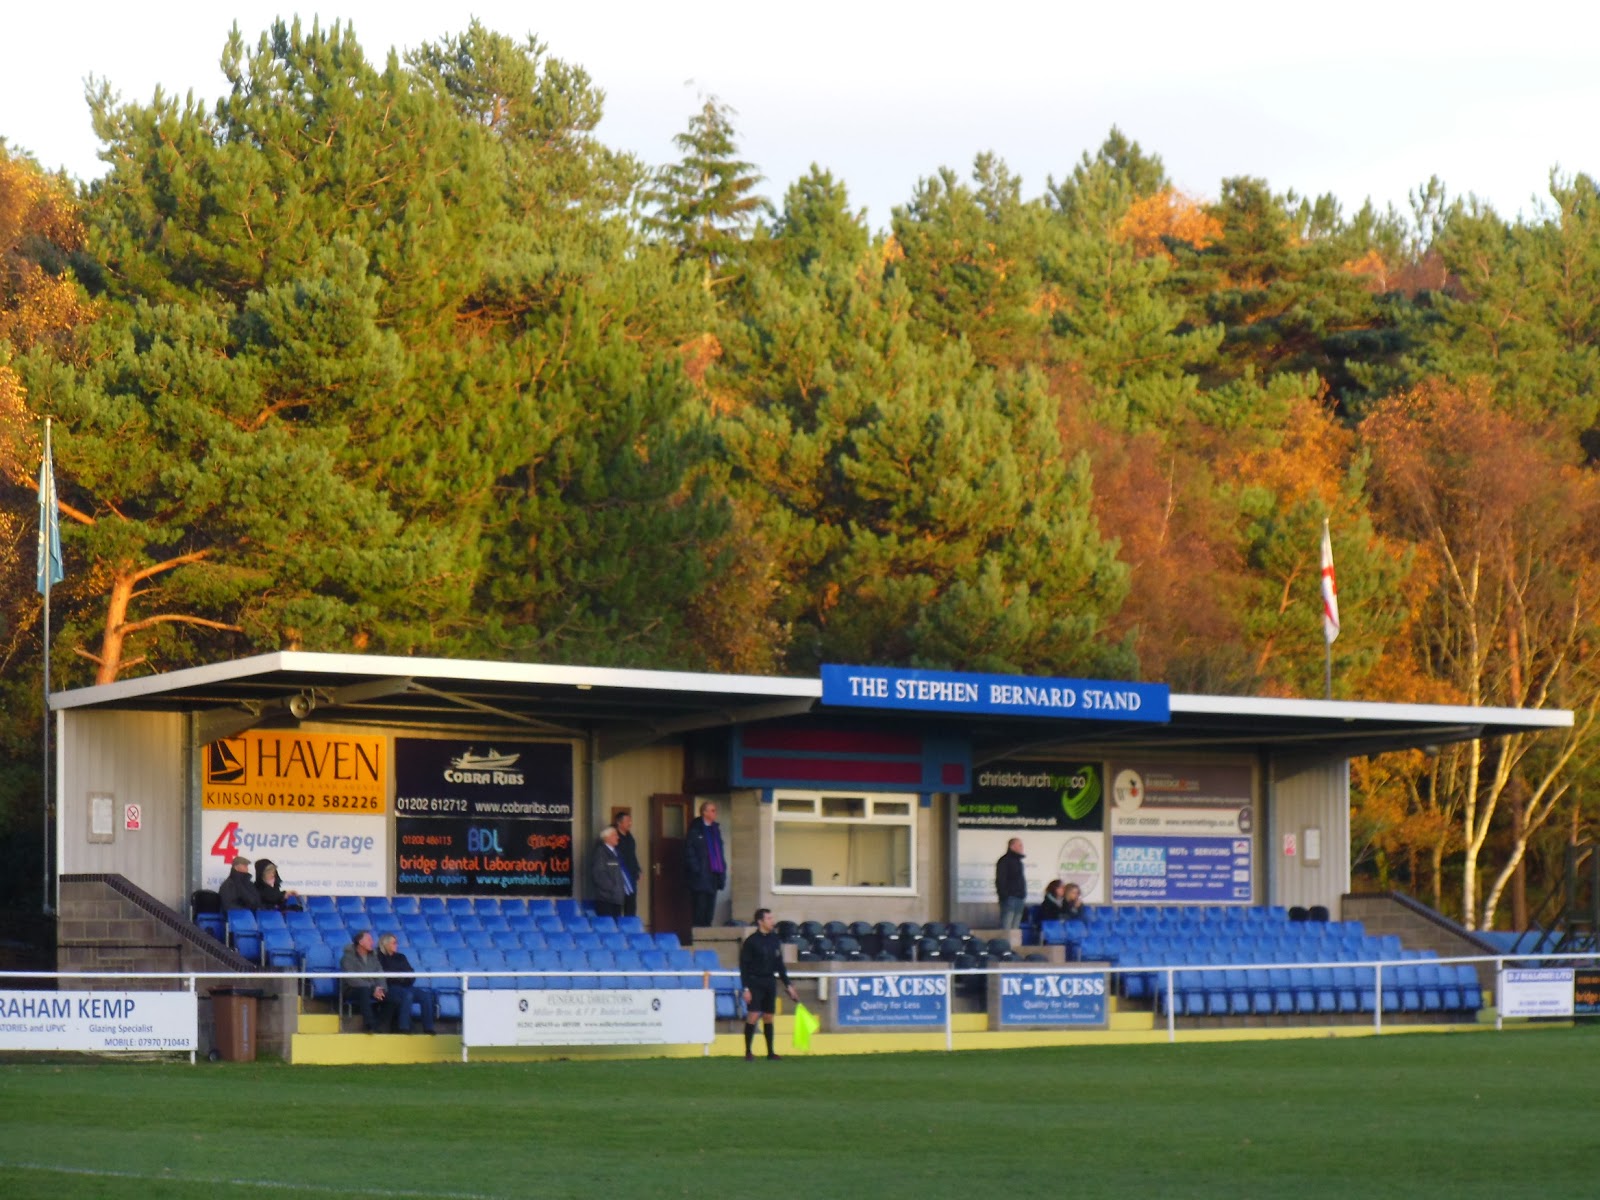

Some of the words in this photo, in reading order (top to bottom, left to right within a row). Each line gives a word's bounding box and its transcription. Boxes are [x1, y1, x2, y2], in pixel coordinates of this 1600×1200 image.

[849, 677, 888, 698] THE
[896, 679, 978, 702] STEPHEN
[990, 685, 1076, 708] BERNARD
[1082, 690, 1141, 711] STAND
[257, 739, 379, 781] HAVEN
[207, 792, 264, 806] KINSON
[268, 793, 315, 807] 01202
[323, 795, 378, 809] 582226
[398, 798, 428, 811] 01202
[431, 799, 467, 811] 612712
[475, 802, 570, 814] www.cobraribs.com
[210, 822, 239, 865] 4
[233, 828, 298, 851] Square
[307, 831, 374, 854] Garage
[468, 827, 503, 852] BDL
[400, 855, 437, 875] bridge
[441, 855, 480, 871] dental
[484, 856, 547, 876] laboratory
[550, 856, 570, 872] ltd
[838, 976, 946, 997] IN-EXCESS
[1002, 976, 1105, 997] IN-EXCESS
[79, 998, 136, 1019] KEMP
[0, 1024, 28, 1033] TORIES
[30, 1024, 44, 1033] and
[46, 1023, 66, 1033] UPVC
[89, 1024, 116, 1034] Glazing
[118, 1023, 153, 1034] Specialist
[104, 1038, 136, 1047] MOBILE:
[138, 1038, 161, 1047] 07970
[163, 1038, 190, 1047] 710443
